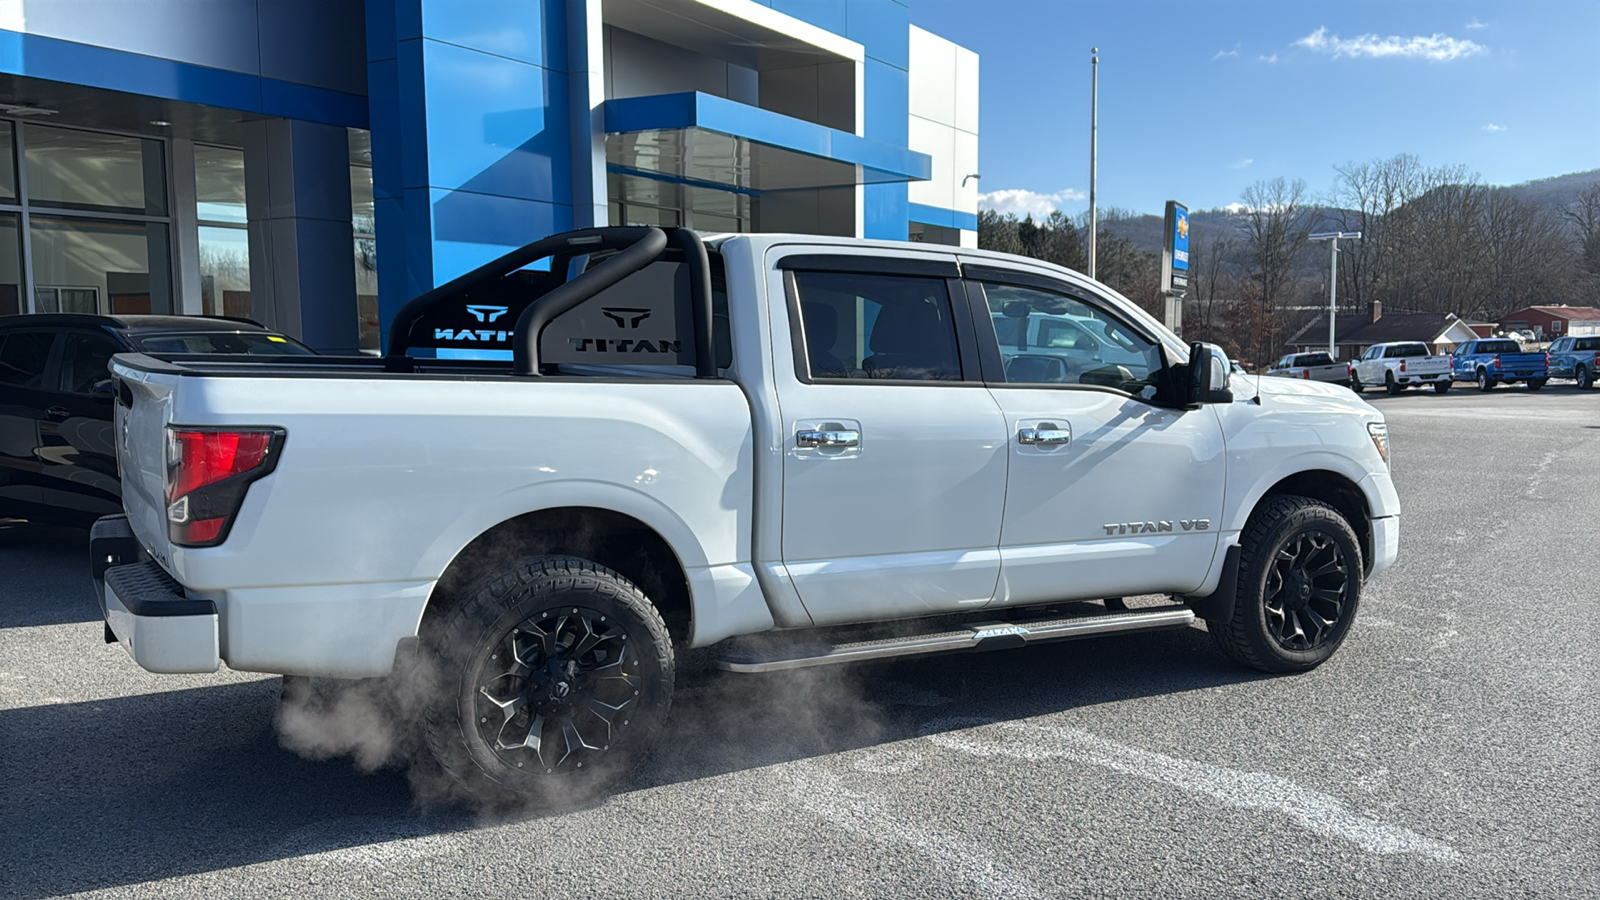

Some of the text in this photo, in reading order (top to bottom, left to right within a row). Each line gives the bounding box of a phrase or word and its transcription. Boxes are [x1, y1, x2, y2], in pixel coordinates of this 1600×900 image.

[567, 338, 682, 353] TITAN
[1103, 519, 1210, 535] TITAN V8
